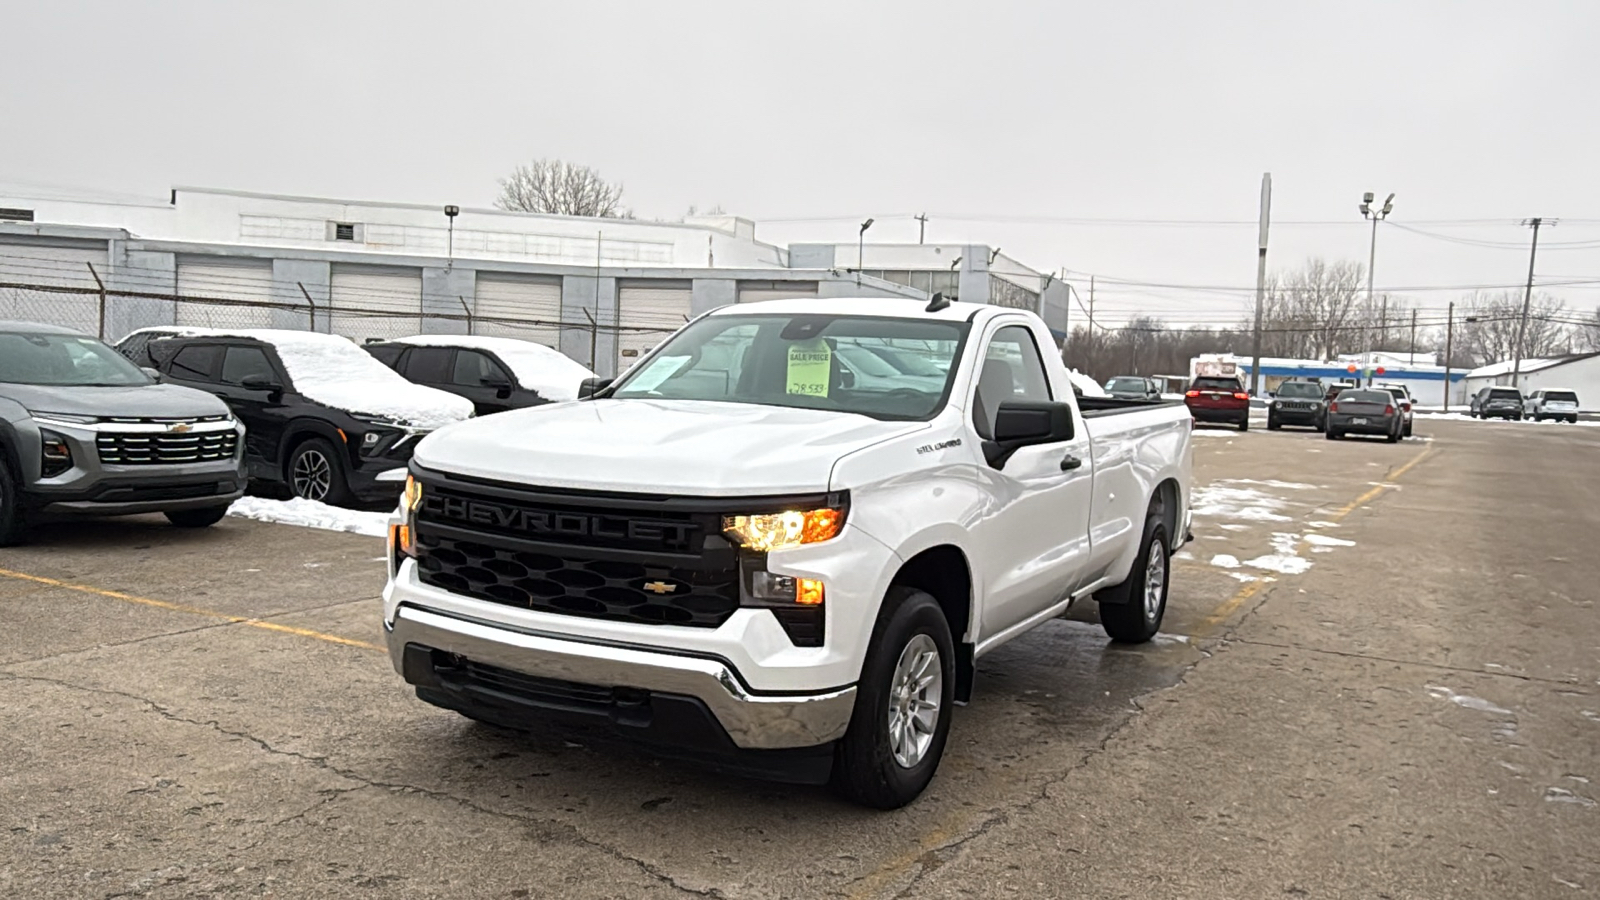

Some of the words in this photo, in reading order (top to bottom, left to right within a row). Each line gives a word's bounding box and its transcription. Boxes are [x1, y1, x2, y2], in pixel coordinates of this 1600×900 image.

[790, 353, 807, 361] SALE
[808, 353, 829, 361] PRICE
[423, 494, 700, 545] CHEVROLET
